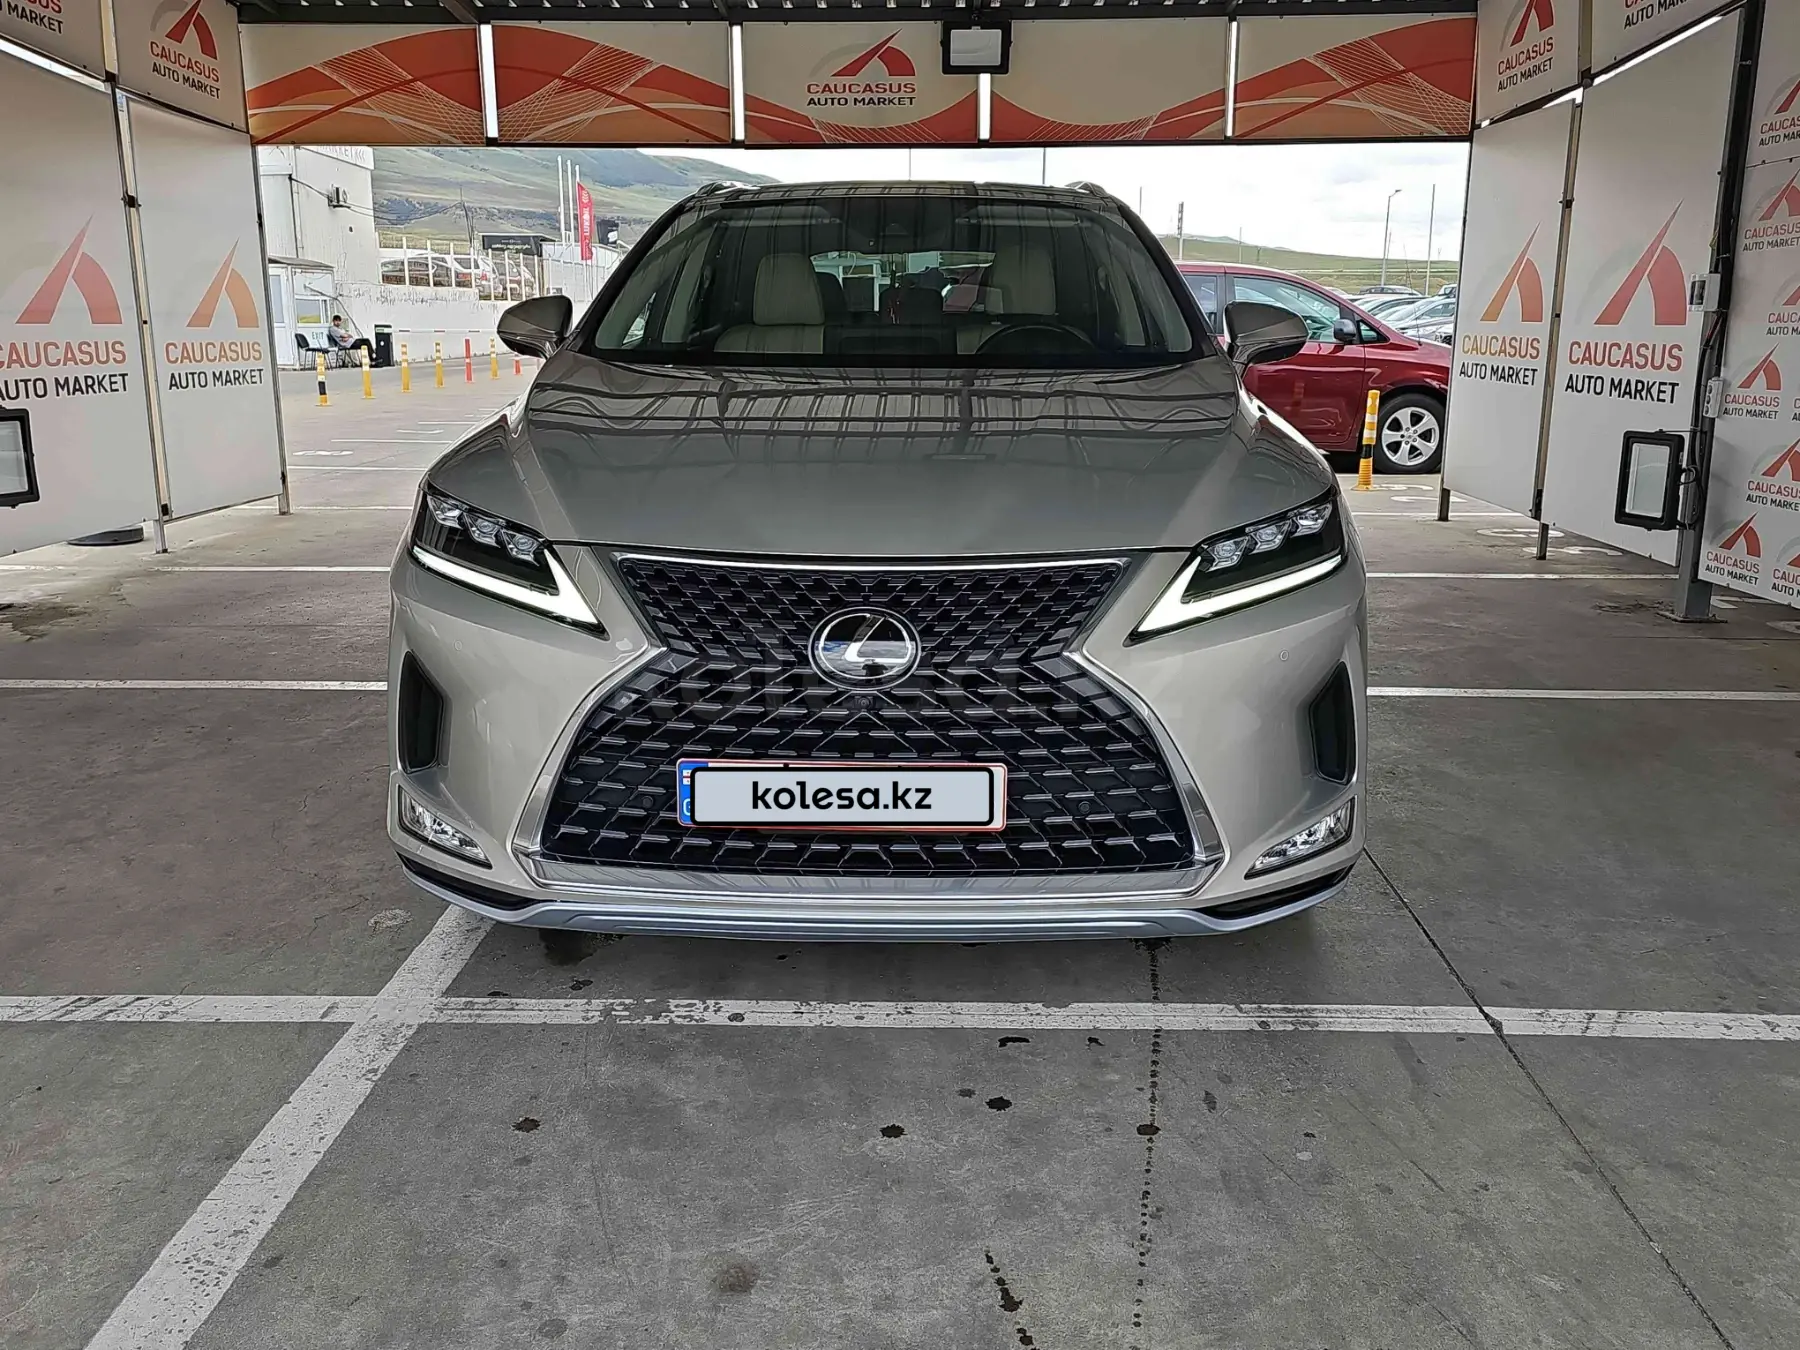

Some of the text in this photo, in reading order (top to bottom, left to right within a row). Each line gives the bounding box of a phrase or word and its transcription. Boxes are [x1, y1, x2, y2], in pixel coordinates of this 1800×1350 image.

[7, 0, 63, 34] MARKET
[1623, 4, 1654, 30] AUTO
[150, 41, 219, 83] CAUCASUS
[1498, 37, 1553, 75] CAUCASUS
[152, 62, 220, 99] AUTO MARKET
[1498, 57, 1553, 92] AUTO MARKET
[806, 82, 916, 94] CAUCASUS
[806, 97, 916, 106] AUTO MARKET
[1759, 134, 1781, 147] AUTO
[1743, 236, 1800, 252] AUTO MARKET
[311, 331, 324, 341] EXIT
[1766, 326, 1788, 335] AUTO
[165, 341, 262, 364] CAUCASUS
[1462, 334, 1541, 360] CAUCASUS
[1568, 341, 1683, 371] CAUCASUS
[54, 373, 128, 397] MARKET
[168, 368, 264, 391] AUTO MARKET
[1459, 361, 1538, 386] AUTO MARKET
[1565, 374, 1679, 404] AUTO MARKET
[1724, 394, 1779, 407] CAUCASUS
[1723, 407, 1779, 419] AUTO MARKET
[1746, 493, 1767, 506] AUTO
[1706, 551, 1760, 574] CAUCASUS
[1705, 564, 1759, 585] AUTO MARKET
[1771, 582, 1794, 596] AUTO
